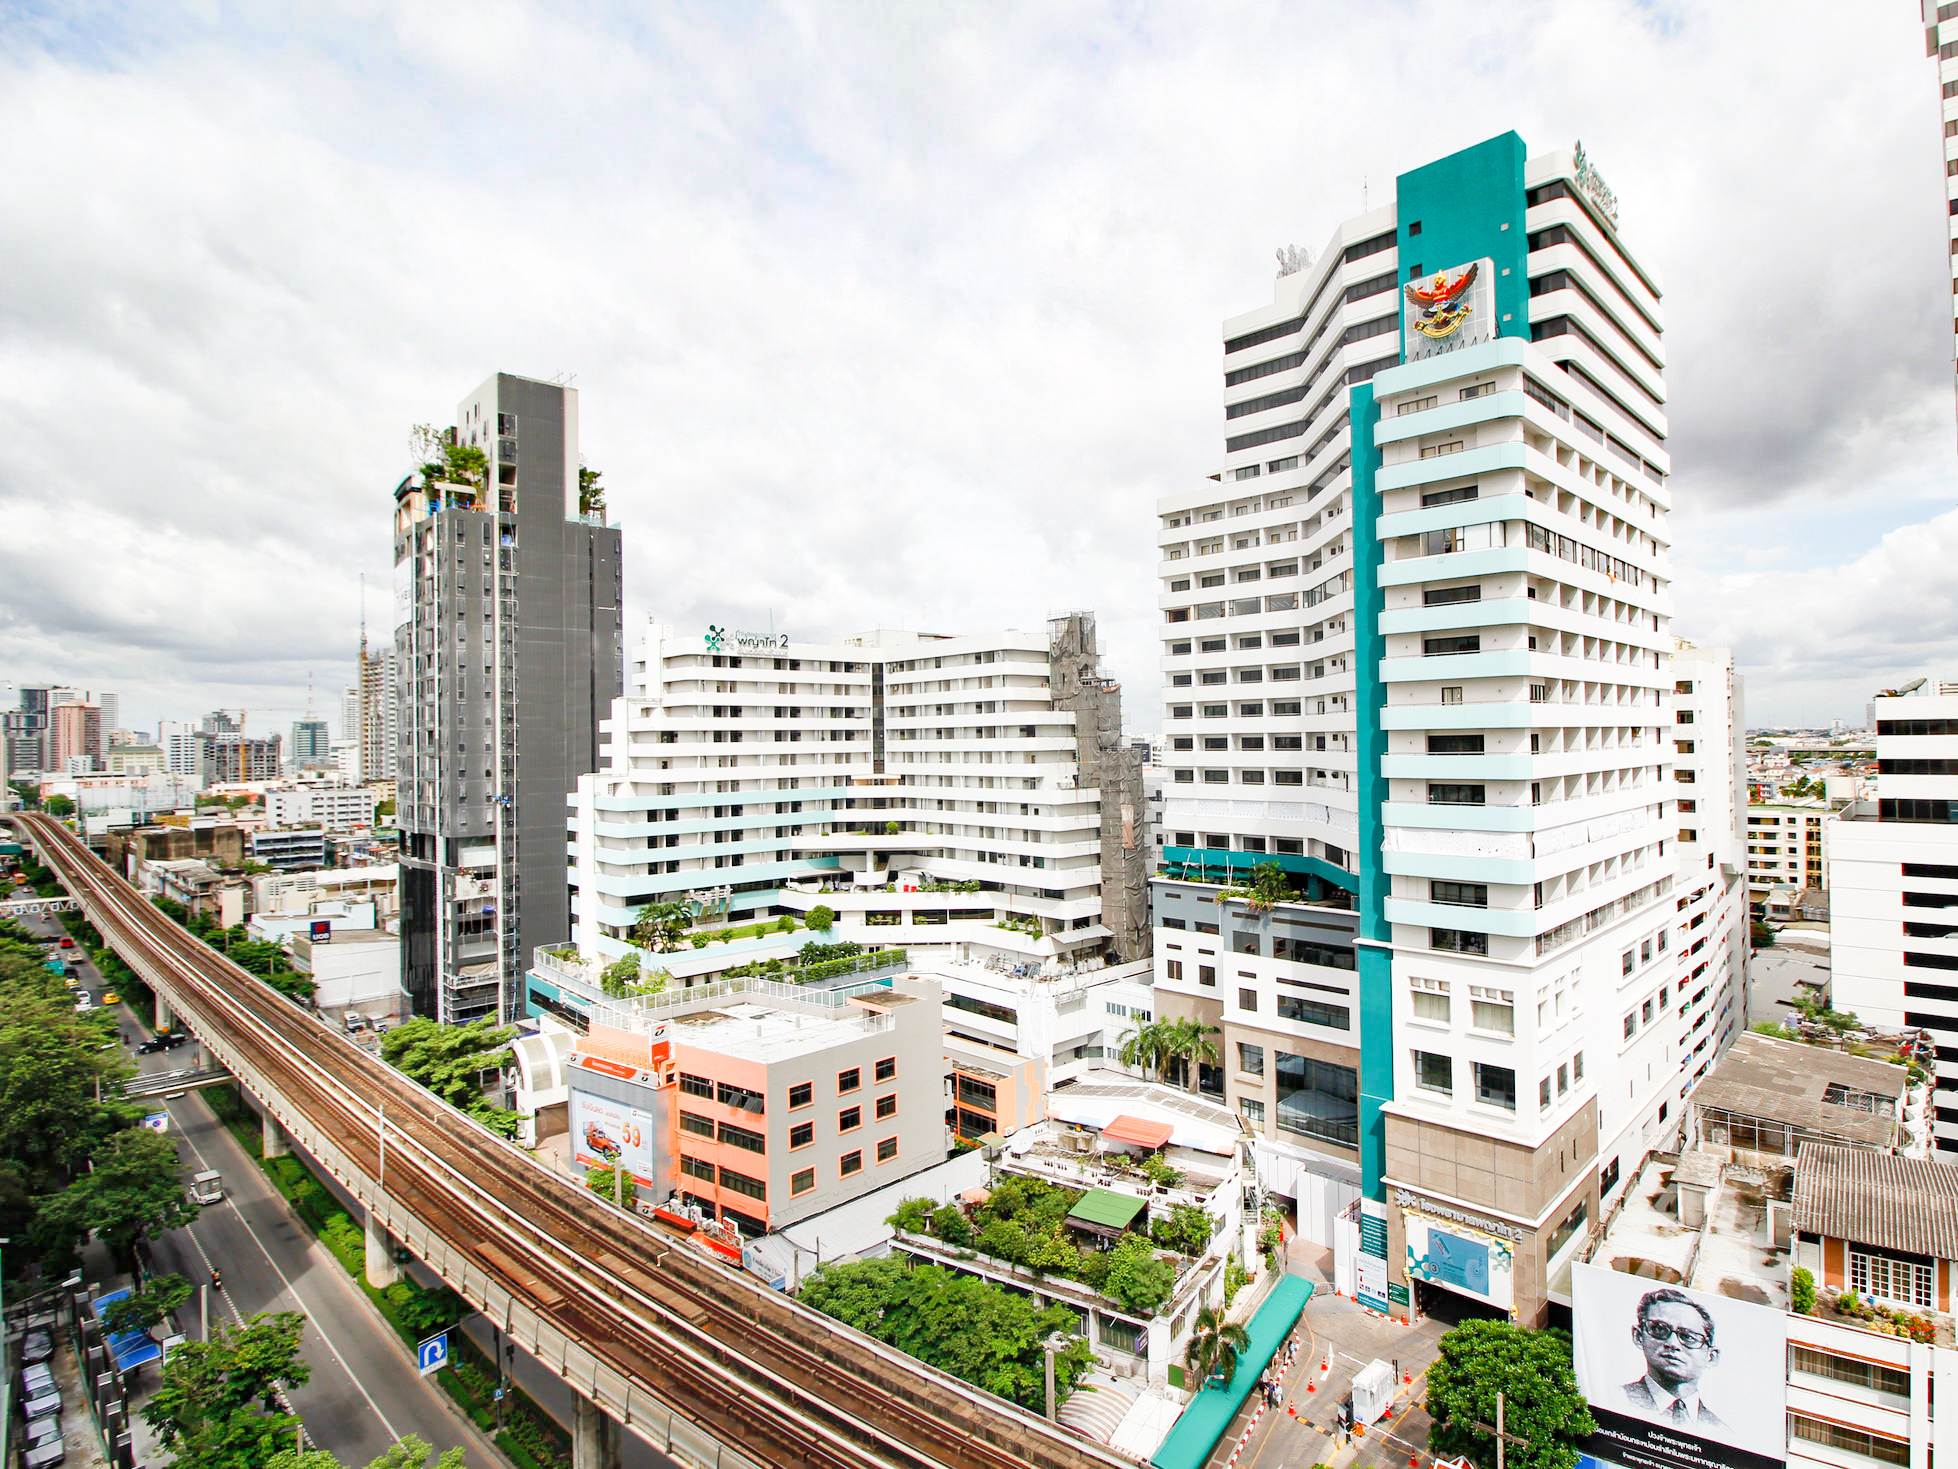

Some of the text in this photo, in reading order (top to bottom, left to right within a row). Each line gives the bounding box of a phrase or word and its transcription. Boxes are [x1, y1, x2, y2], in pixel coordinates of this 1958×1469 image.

[780, 634, 789, 648] 2
[312, 932, 330, 940] UOB
[622, 1121, 641, 1148] 59
[1514, 1228, 1524, 1242] 2
